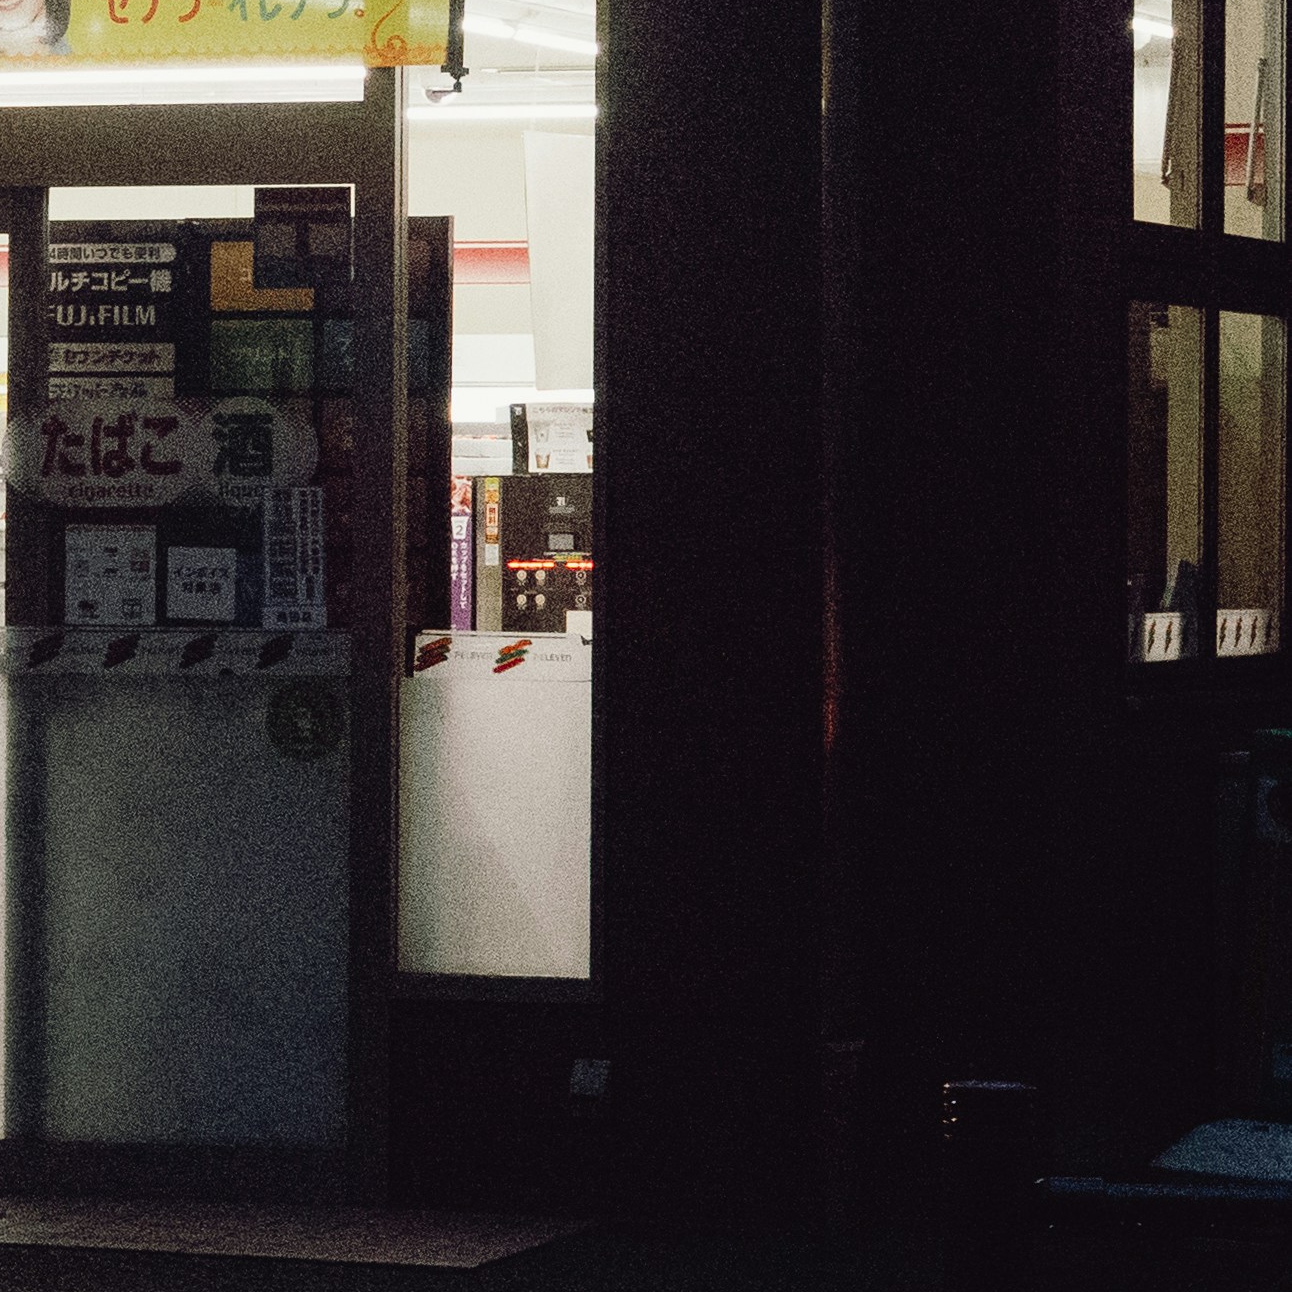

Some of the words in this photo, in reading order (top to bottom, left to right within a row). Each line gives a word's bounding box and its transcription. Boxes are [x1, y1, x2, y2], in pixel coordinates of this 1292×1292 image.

[40, 412, 182, 478] たばこ
[212, 411, 273, 476] 酒
